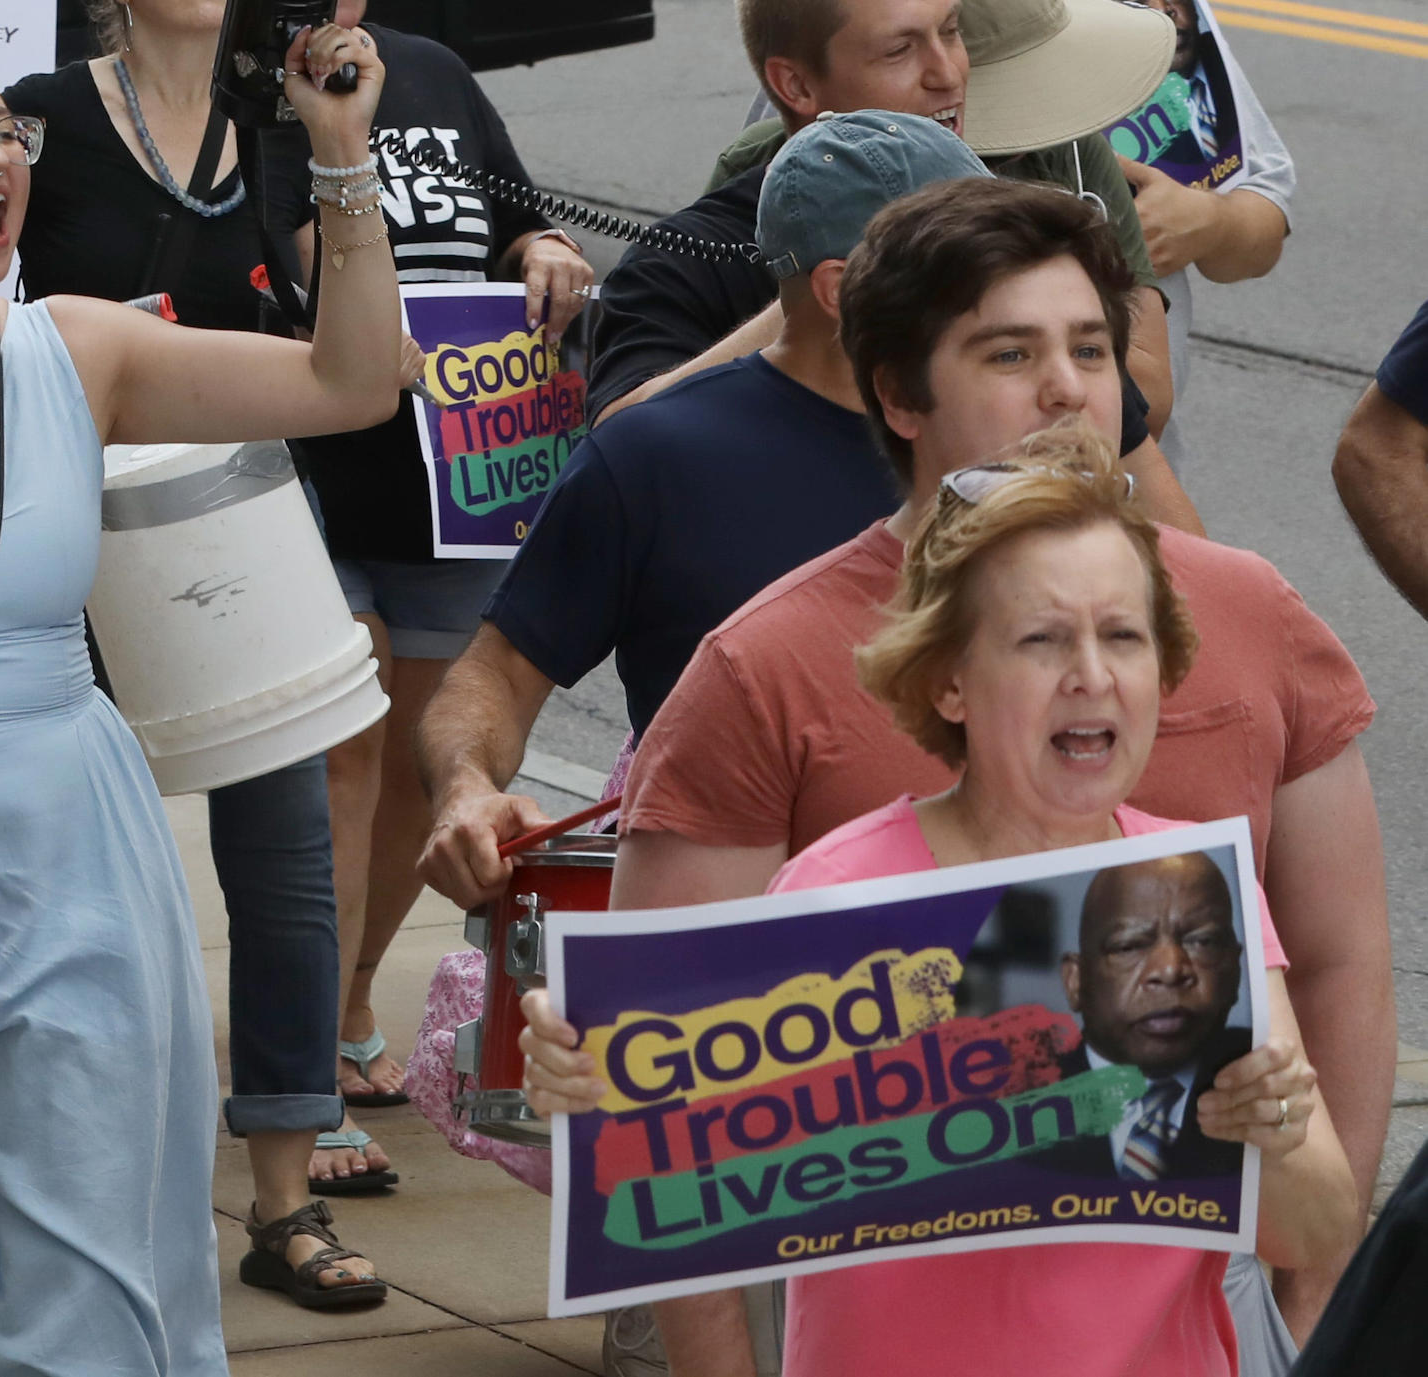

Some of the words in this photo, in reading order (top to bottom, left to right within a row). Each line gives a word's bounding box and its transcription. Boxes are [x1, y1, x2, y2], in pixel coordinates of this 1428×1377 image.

[436, 329, 548, 401] Good
[447, 380, 572, 452] Trouble
[458, 445, 549, 507] Lives
[605, 962, 902, 1102] Good
[627, 1030, 1012, 1173] Trouble
[630, 1136, 908, 1239] Lives
[927, 1094, 1078, 1166] On
[776, 1234, 843, 1259] Our
[853, 1203, 1040, 1246] Freedoms.
[1052, 1192, 1119, 1221] Our
[1131, 1190, 1228, 1224] Vote.
